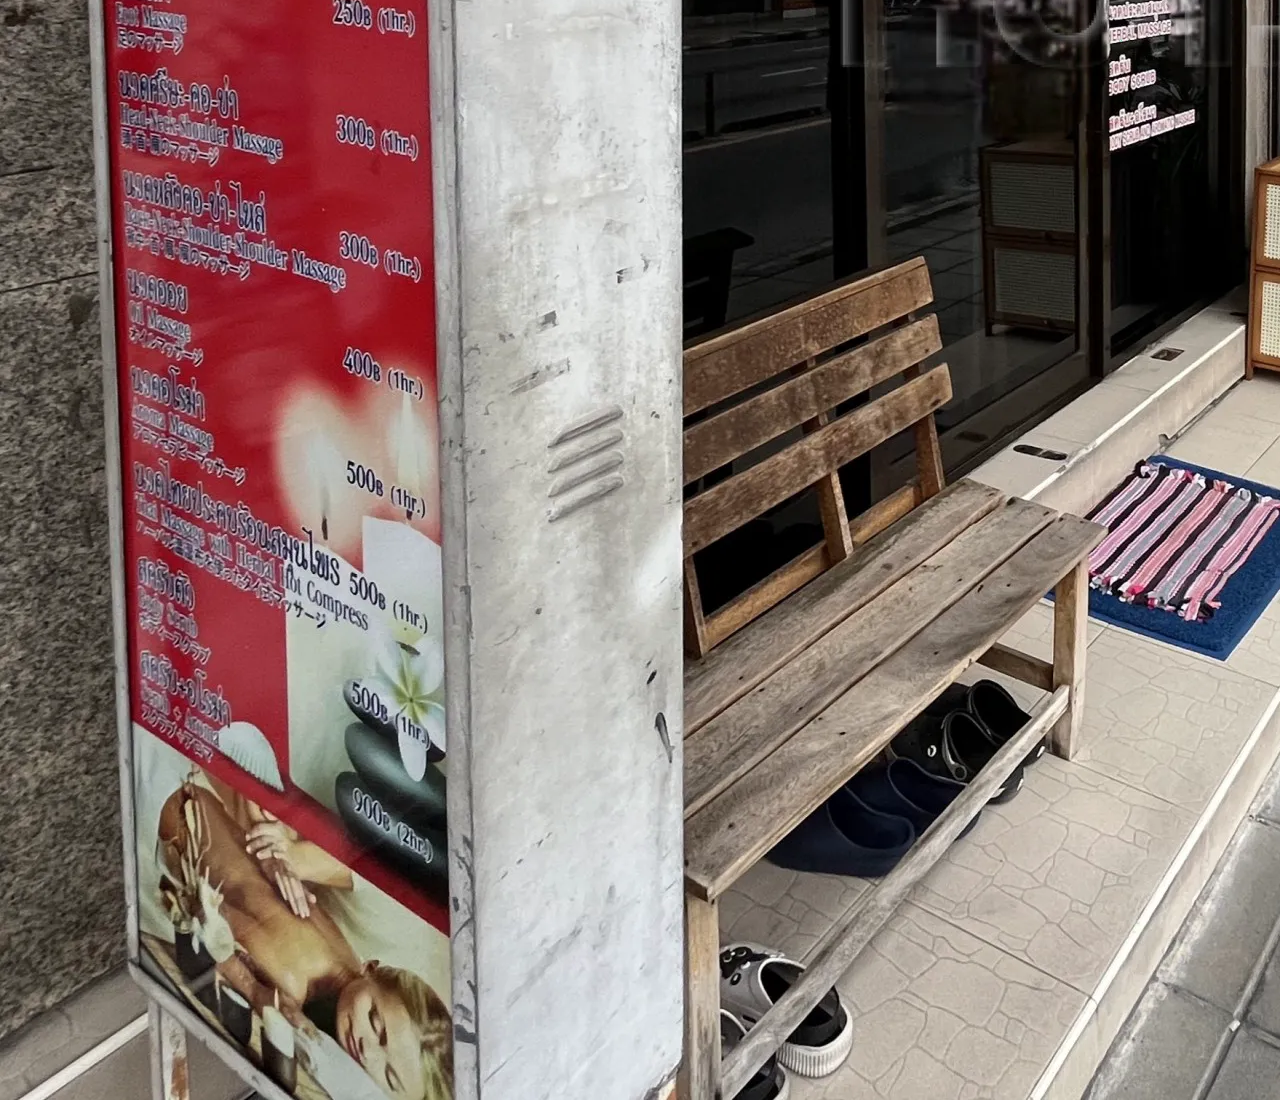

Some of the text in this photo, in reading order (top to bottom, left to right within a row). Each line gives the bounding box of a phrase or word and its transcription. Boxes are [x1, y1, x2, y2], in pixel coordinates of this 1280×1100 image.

[116, 2, 188, 34] Foot Massage
[1138, 19, 1172, 39] MASSAGE
[1131, 69, 1156, 90] SCRUB
[233, 126, 283, 164] Massage
[292, 248, 346, 293] Massage
[147, 305, 191, 347] Massage
[168, 412, 214, 455] Massage
[160, 502, 206, 546] Massage
[236, 540, 276, 585] Herbal
[306, 580, 369, 631] Compress
